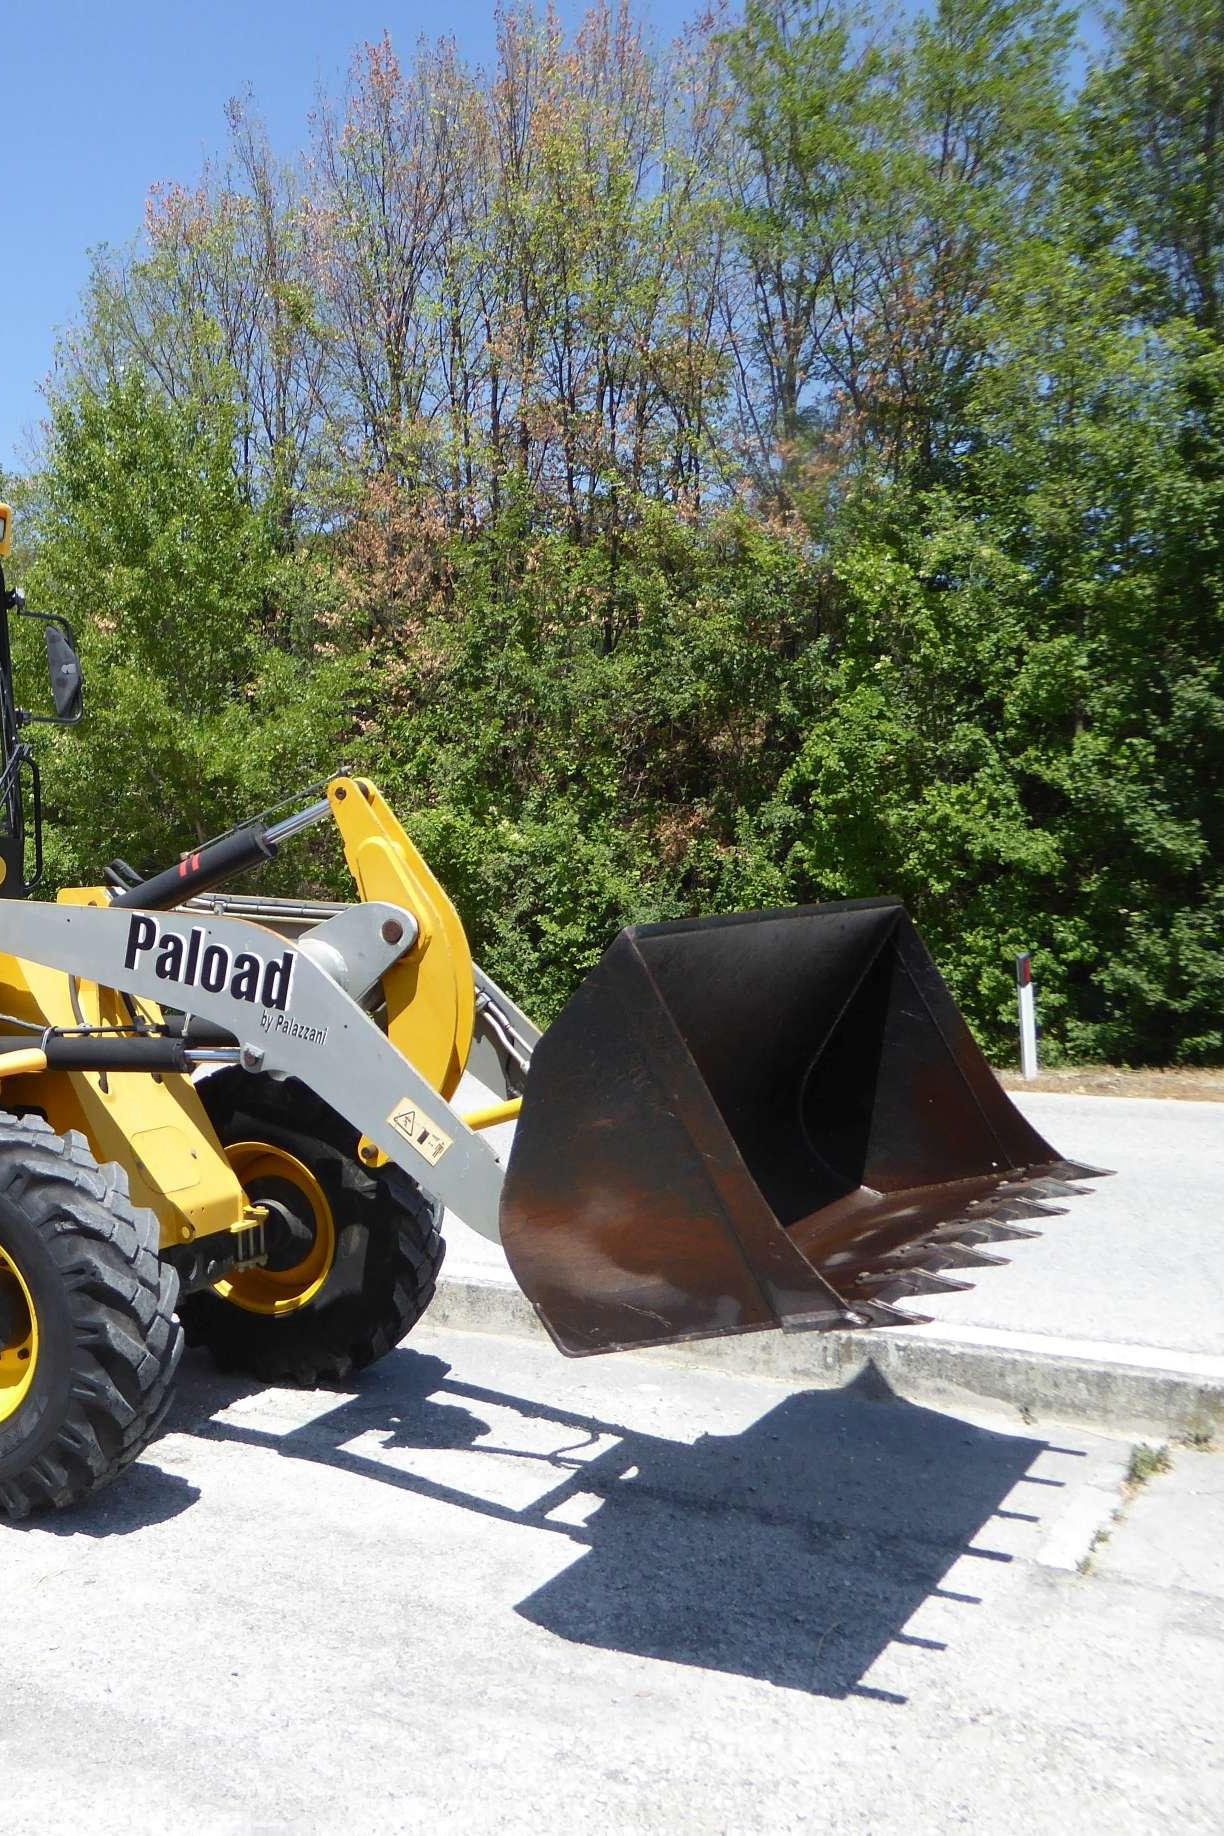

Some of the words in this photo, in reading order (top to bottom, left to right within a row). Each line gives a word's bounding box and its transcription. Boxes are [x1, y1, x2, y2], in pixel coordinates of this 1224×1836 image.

[124, 912, 297, 1011] Paload
[260, 1010, 274, 1033] by
[275, 1014, 328, 1046] Palazzani
